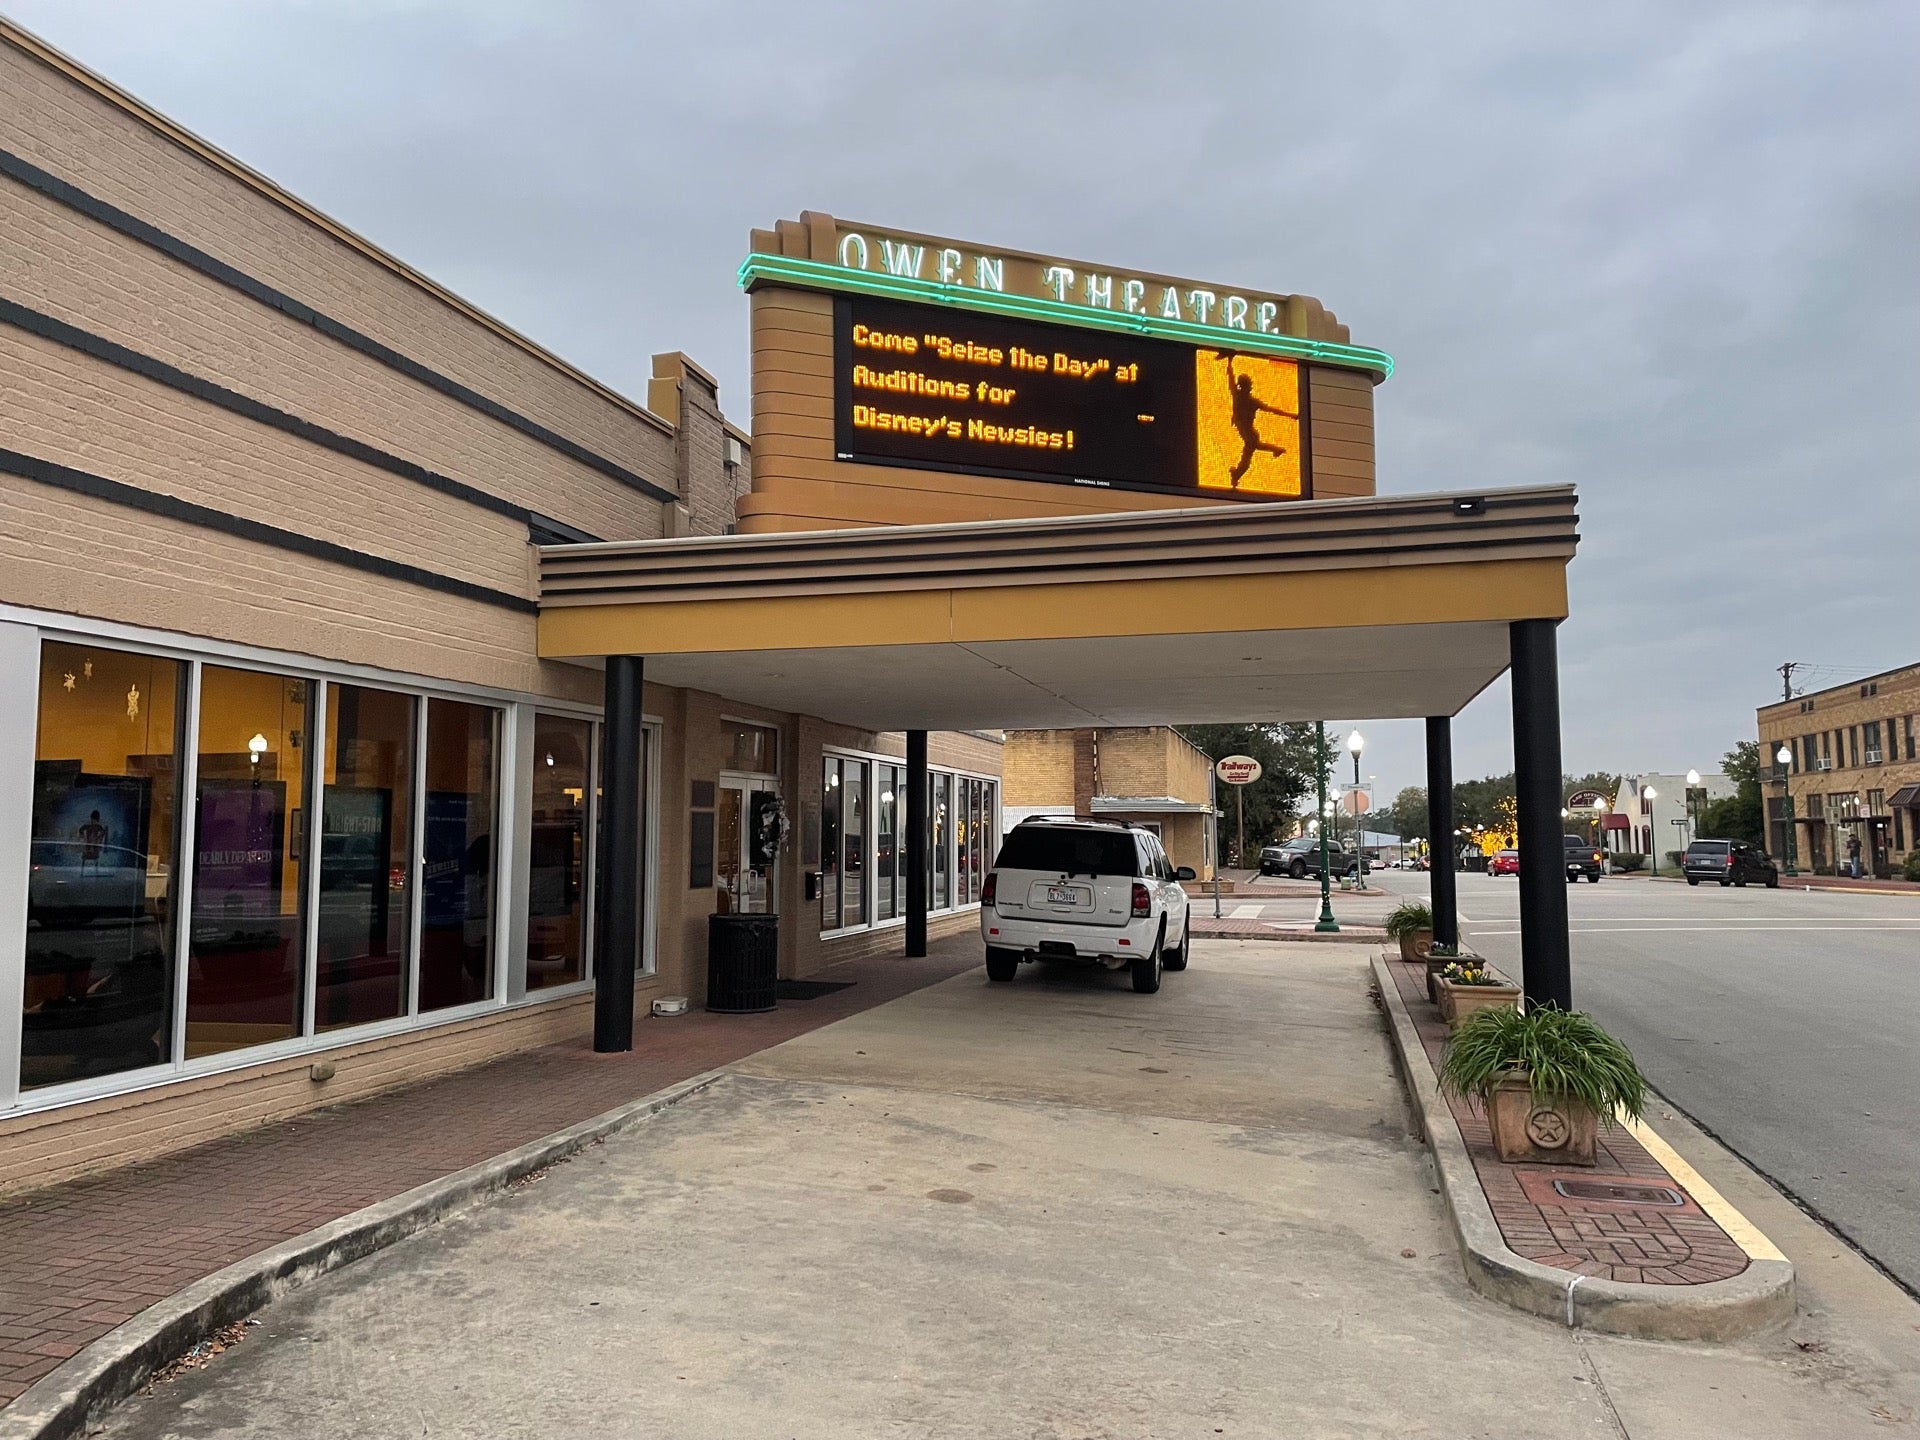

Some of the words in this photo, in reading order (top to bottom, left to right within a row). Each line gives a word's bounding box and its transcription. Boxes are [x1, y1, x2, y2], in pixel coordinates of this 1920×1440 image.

[838, 233, 1004, 292] OWEN
[1043, 266, 1279, 335] THEATRE
[853, 324, 918, 353] Come
[924, 334, 1003, 365] "Seize
[1009, 347, 1048, 370] the
[1053, 352, 1110, 378] Day"
[1115, 363, 1138, 382] at
[853, 365, 970, 399] Auditions
[976, 380, 1016, 404] for
[853, 405, 962, 437] Disney's
[968, 418, 1074, 450] Newsies!
[1572, 794, 1583, 803] LAW
